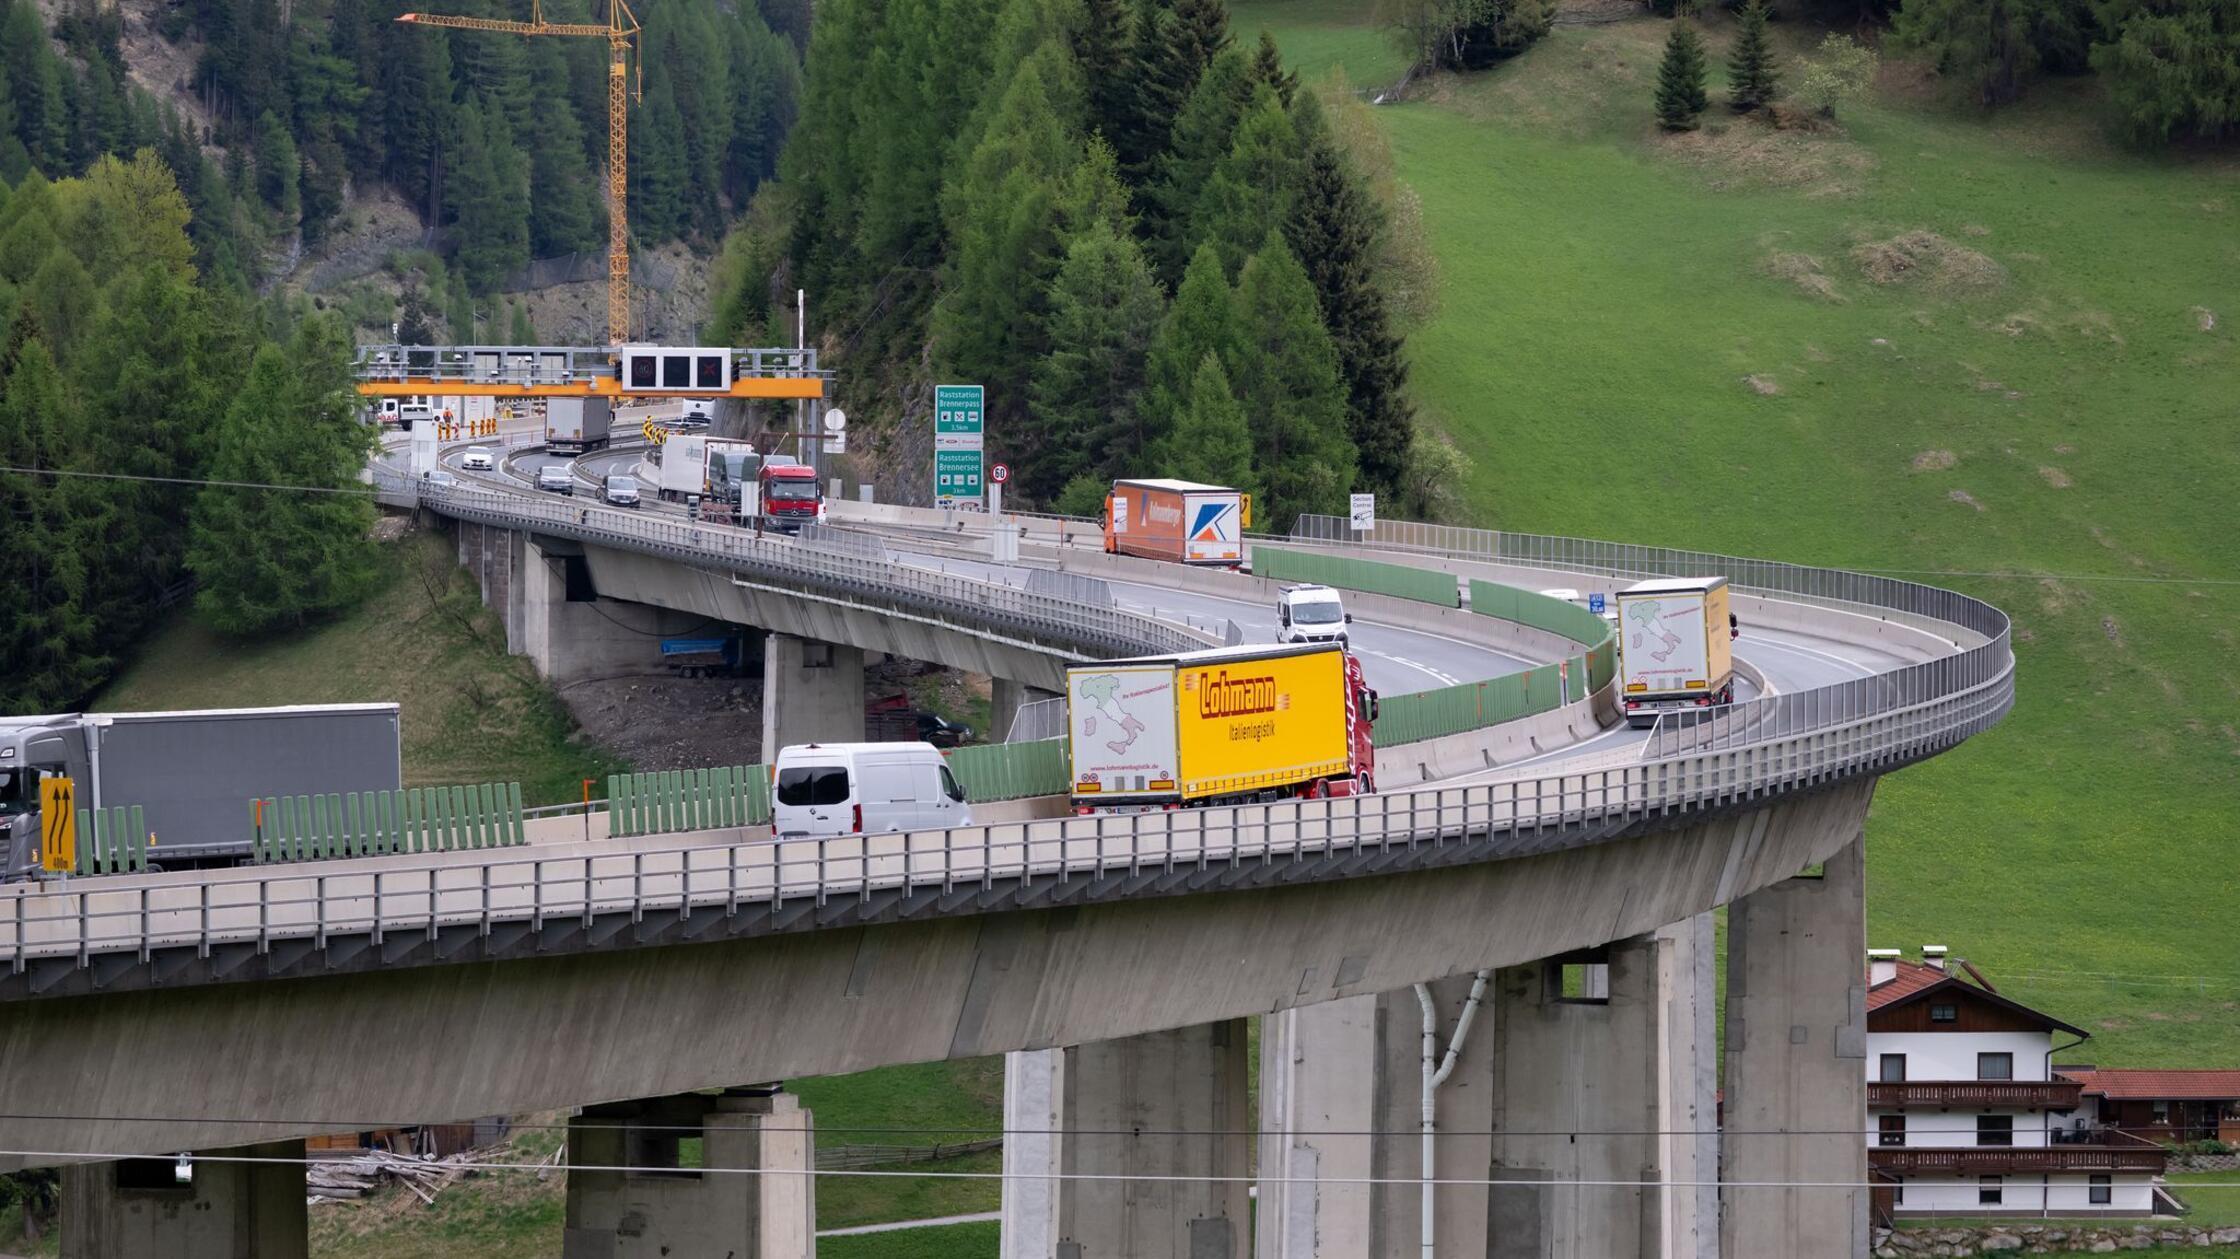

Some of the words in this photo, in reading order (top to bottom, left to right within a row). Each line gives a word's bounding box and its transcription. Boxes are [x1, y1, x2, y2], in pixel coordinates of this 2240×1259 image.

[939, 400, 980, 408] Brennerpass
[994, 468, 1004, 478] 60
[1200, 671, 1275, 719] Lohmann
[1229, 720, 1275, 742] Italienlogistik
